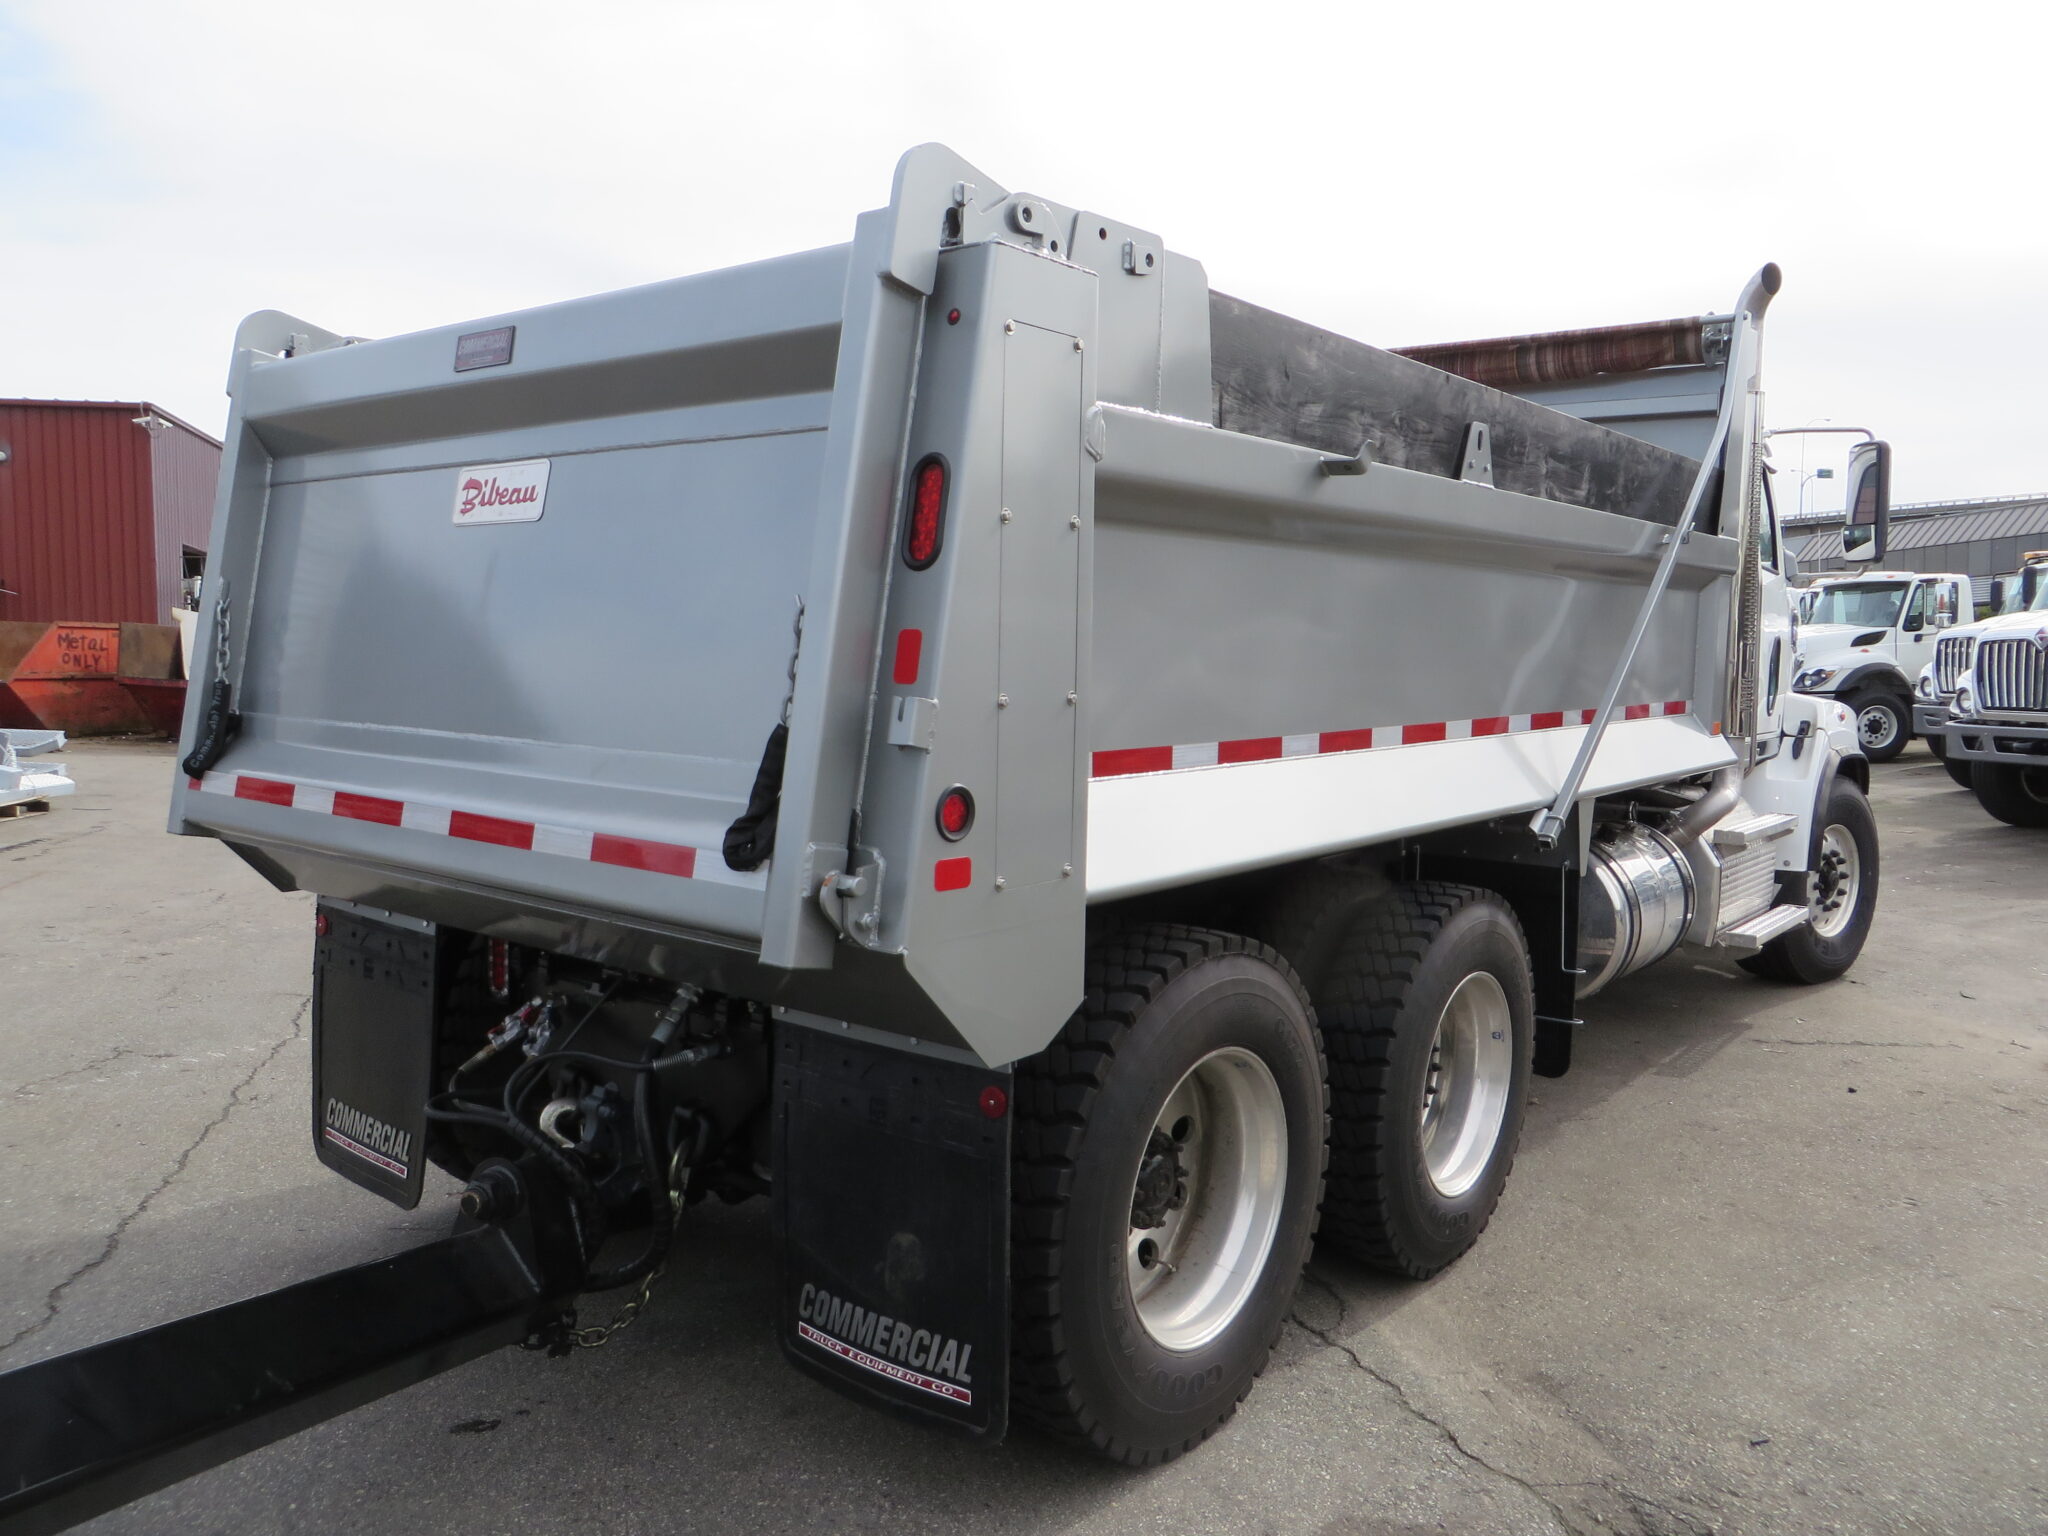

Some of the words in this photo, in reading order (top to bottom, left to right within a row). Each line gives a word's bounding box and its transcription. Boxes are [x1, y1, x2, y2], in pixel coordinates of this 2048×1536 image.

[460, 477, 539, 516] Bibeau
[62, 652, 102, 672] ONLY
[327, 1098, 411, 1162] COMMERCIAL
[799, 1283, 972, 1383] COMMERCIAL
[806, 1328, 844, 1353] TRUCK
[847, 1350, 925, 1385] EQUIPMENT
[931, 1382, 958, 1397] CO.
